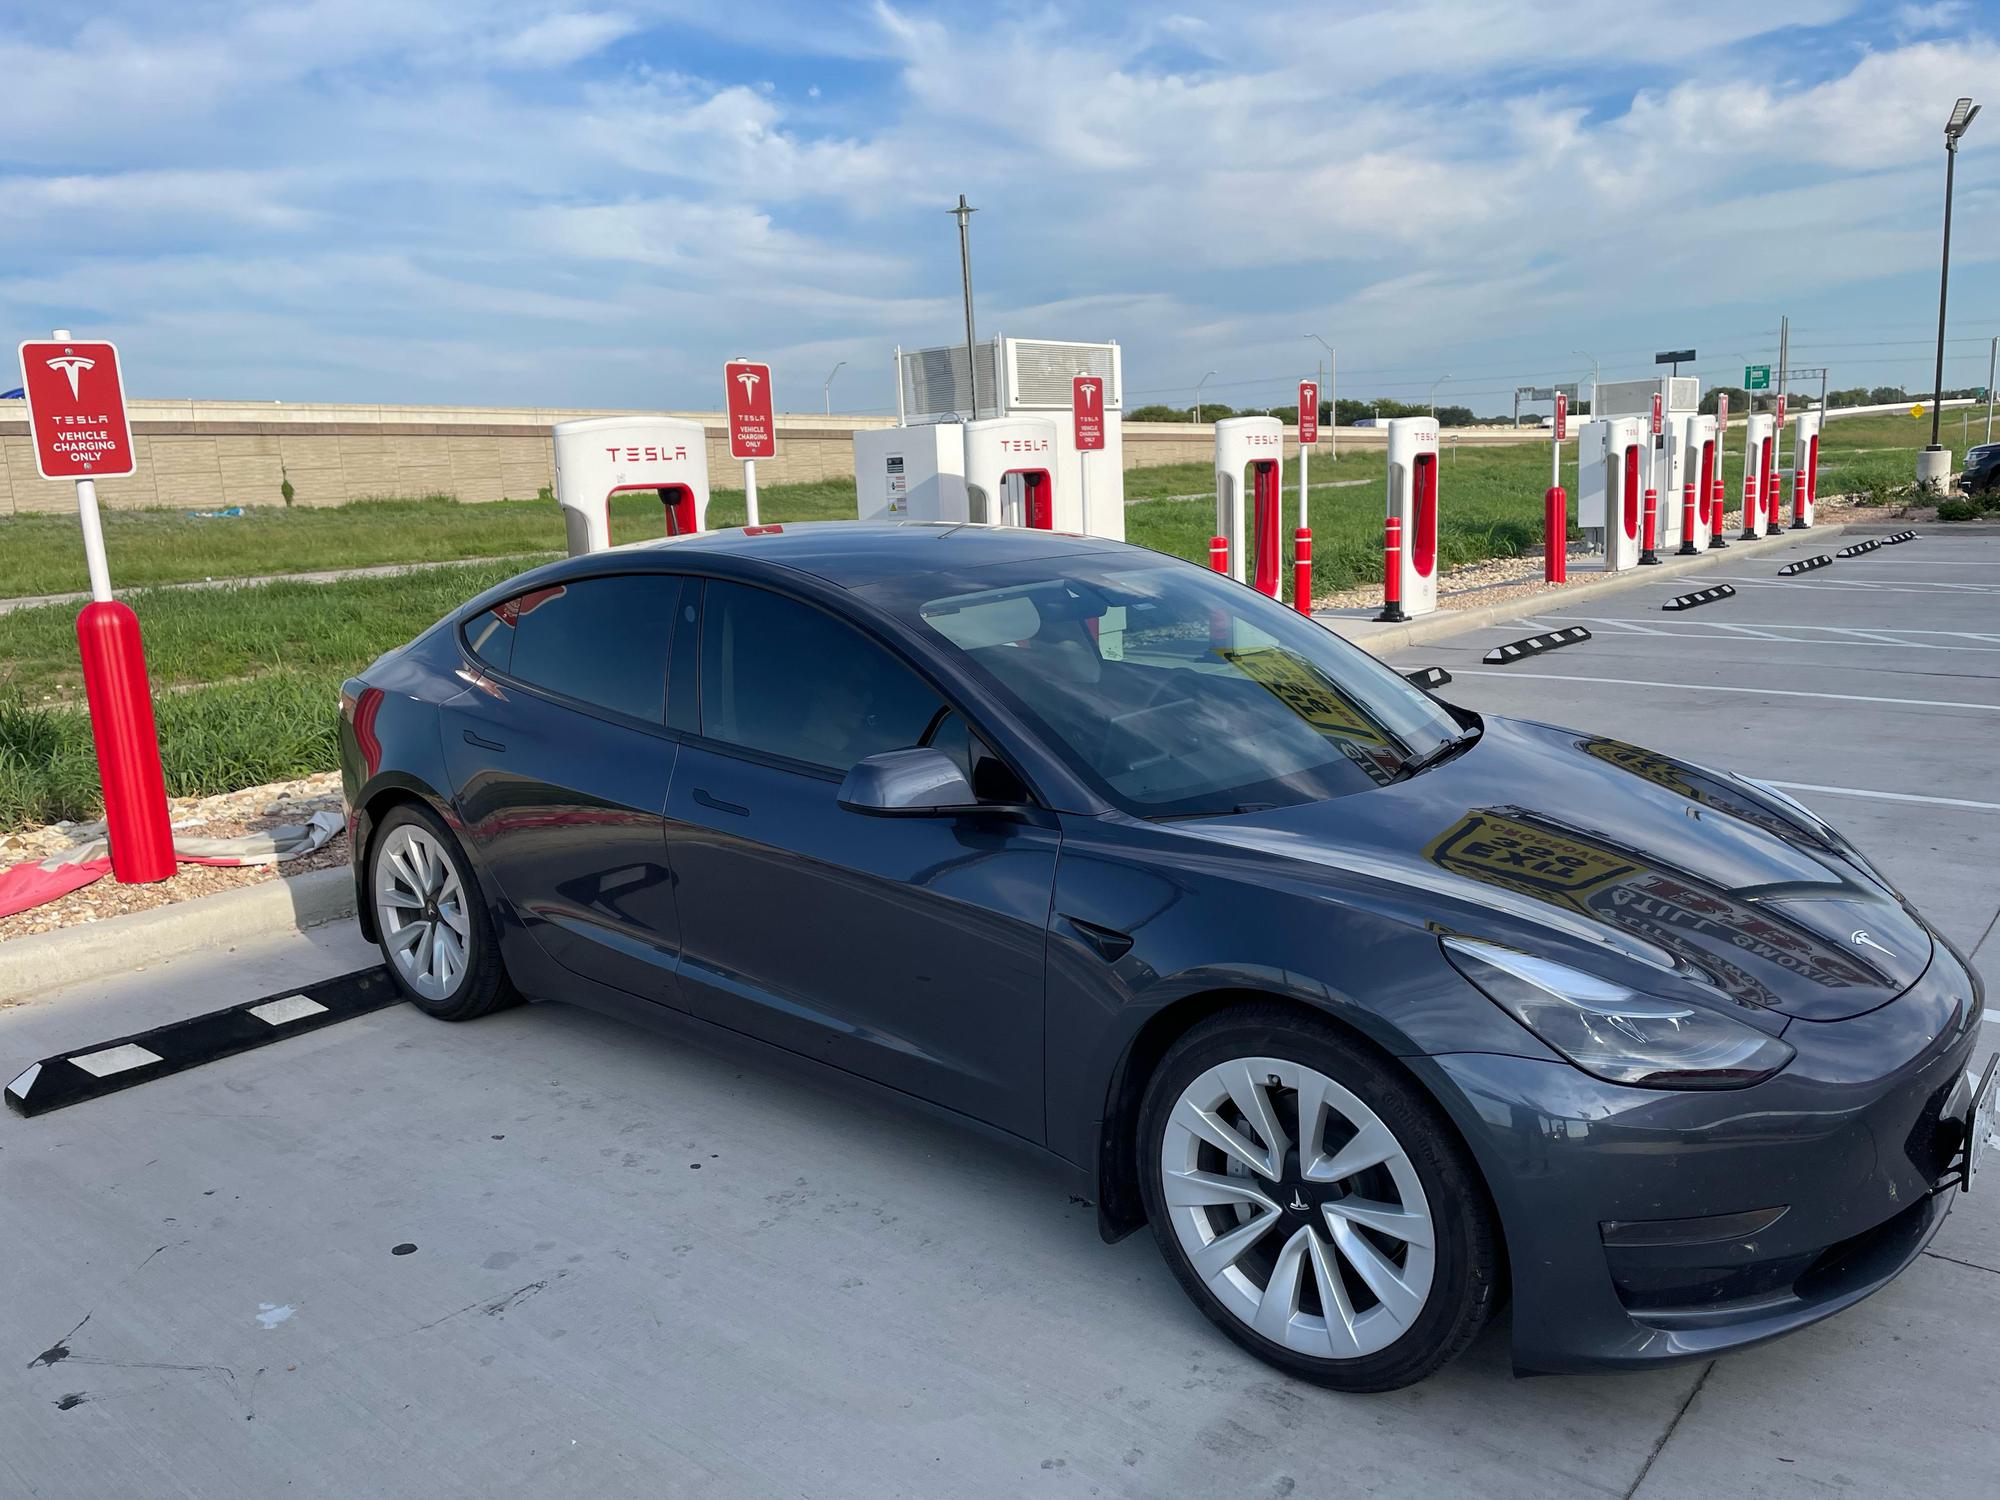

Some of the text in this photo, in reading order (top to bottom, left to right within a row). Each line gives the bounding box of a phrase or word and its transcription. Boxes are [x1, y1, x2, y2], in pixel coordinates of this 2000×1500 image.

[52, 415, 108, 424] TESLA
[738, 414, 765, 422] TESLA
[57, 431, 108, 441] VEHICLE
[1245, 435, 1278, 445] TESLA
[53, 441, 116, 452] CHARGING
[1000, 440, 1048, 452] TESLA
[70, 452, 101, 462] ONLY
[605, 446, 687, 462] TESLA
